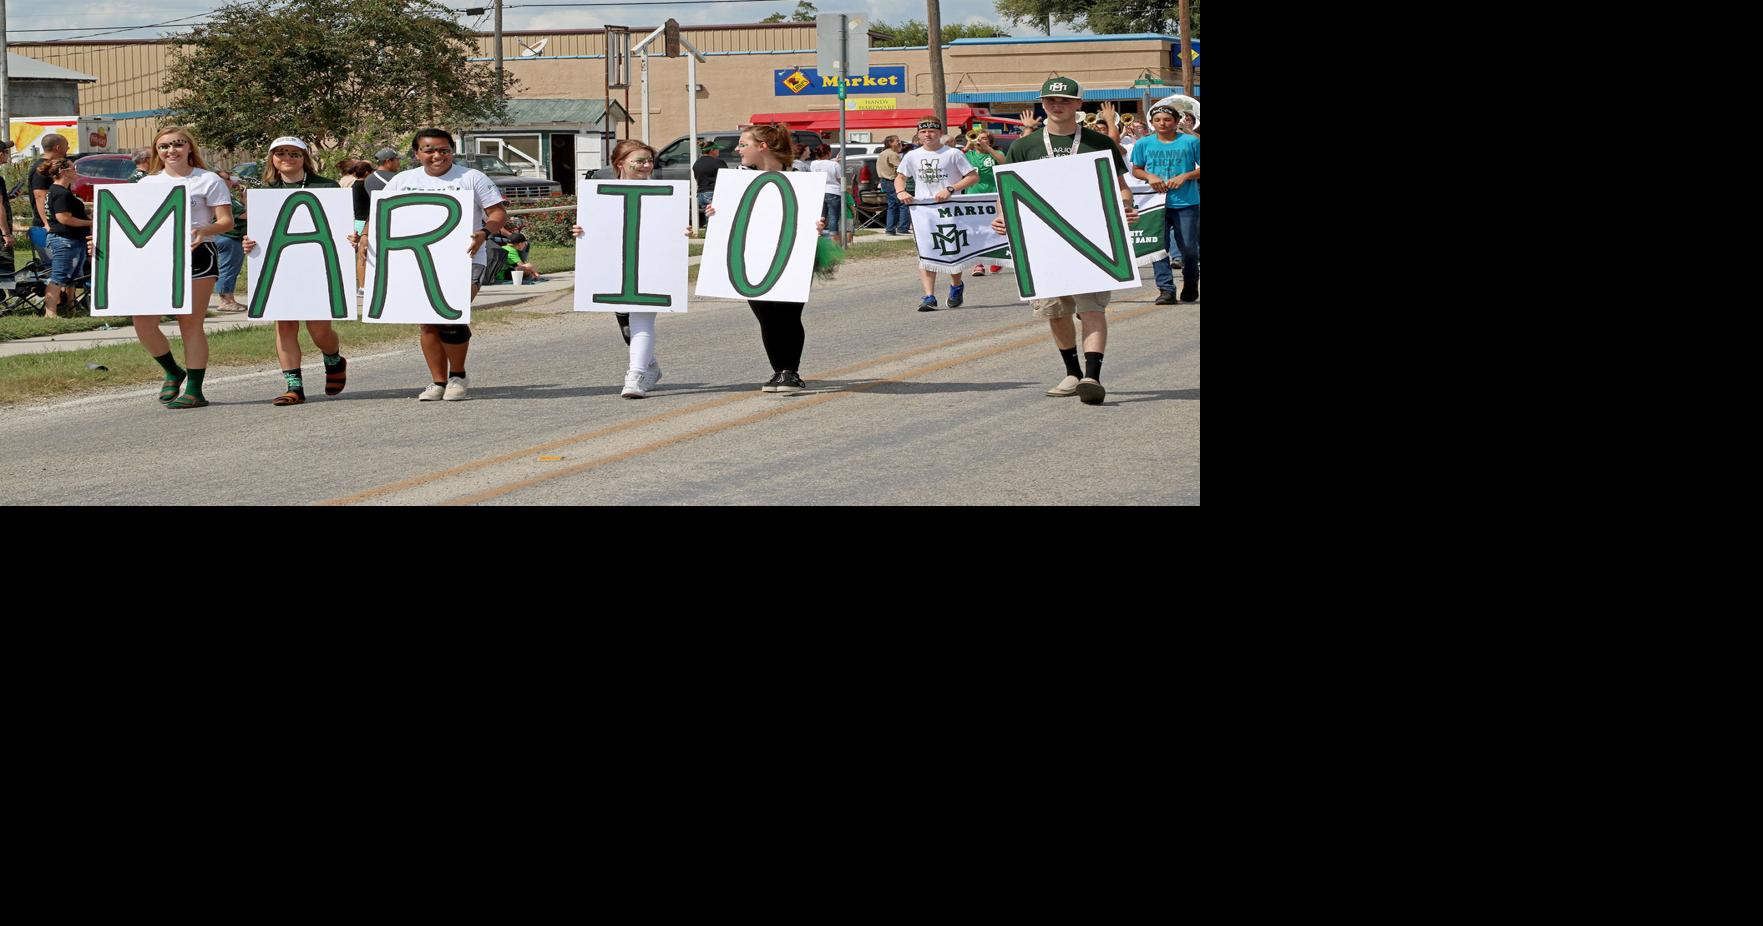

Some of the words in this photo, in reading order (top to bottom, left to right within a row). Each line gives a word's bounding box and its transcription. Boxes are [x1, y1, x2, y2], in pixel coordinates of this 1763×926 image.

[938, 205, 996, 218] MARIO
[1148, 149, 1187, 158] WANNA
[95, 186, 186, 310] M
[249, 191, 347, 318] A
[369, 193, 462, 319] R
[593, 184, 673, 306] I
[727, 171, 799, 298] O
[996, 157, 1135, 298] N
